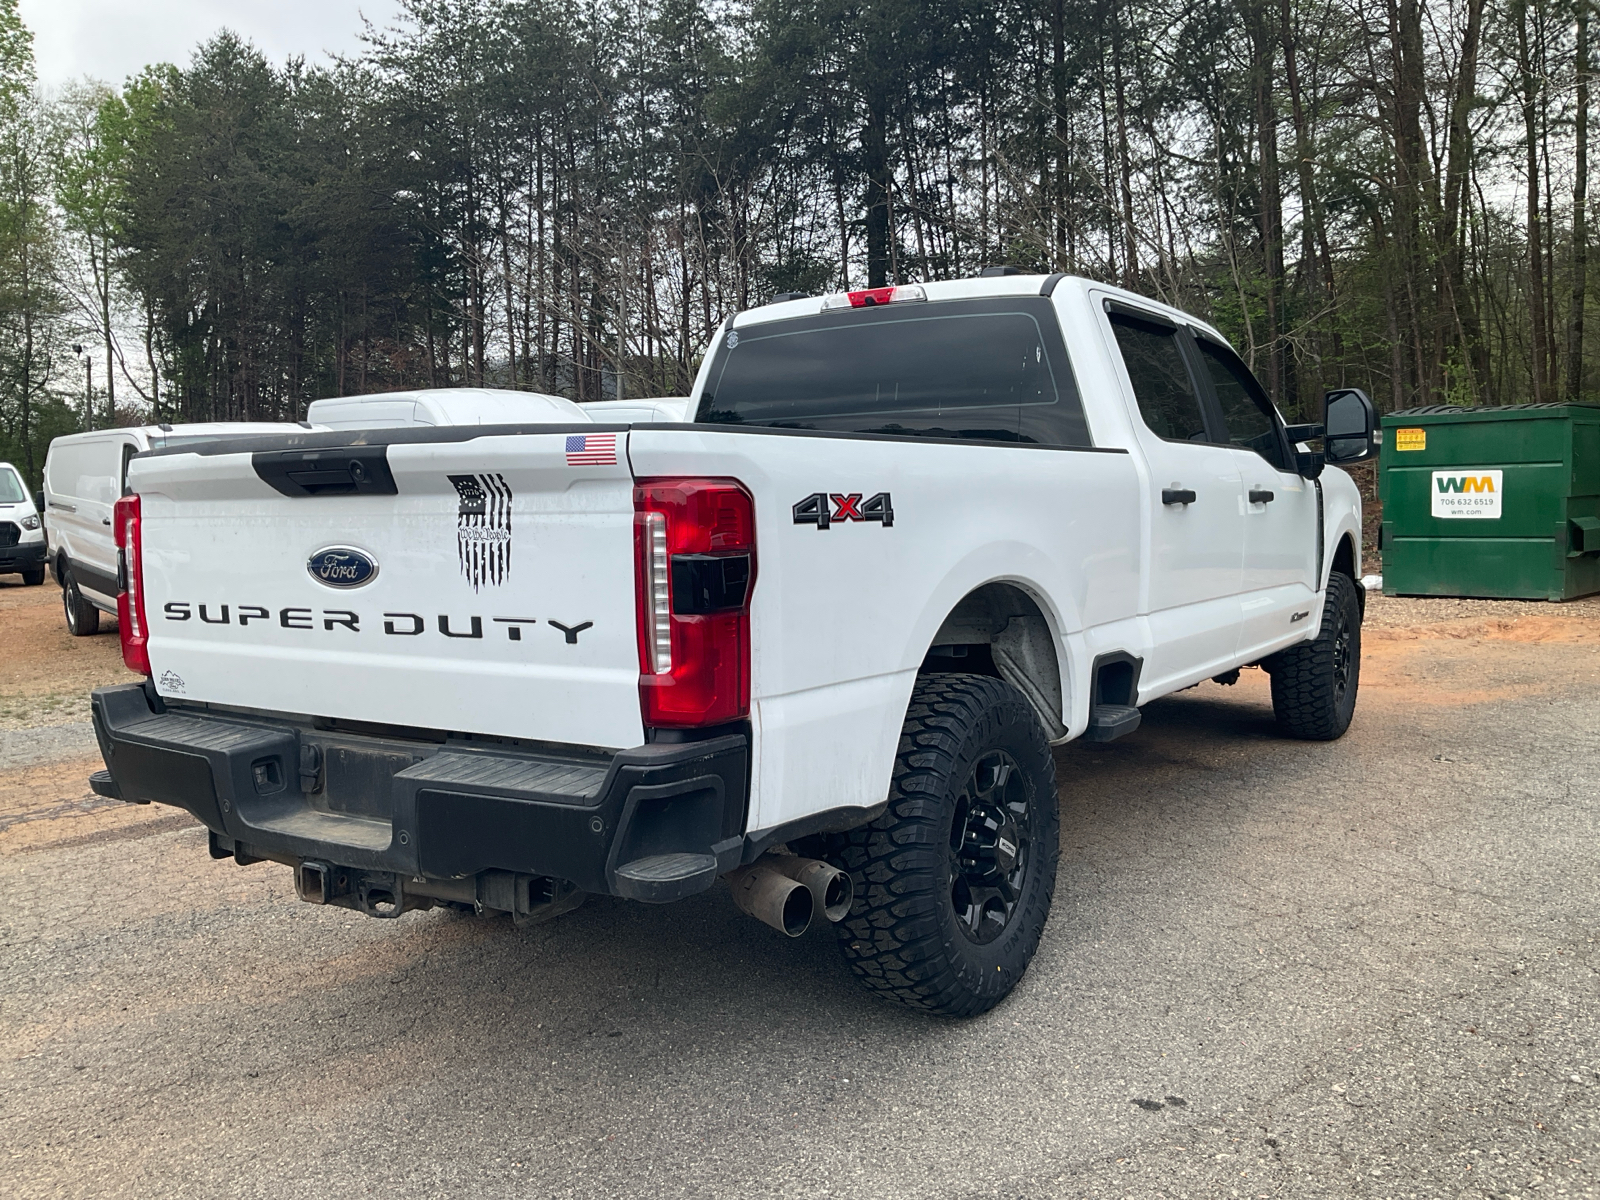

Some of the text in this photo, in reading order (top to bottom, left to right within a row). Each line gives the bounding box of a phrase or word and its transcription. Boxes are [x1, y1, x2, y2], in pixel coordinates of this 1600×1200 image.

[1436, 477, 1495, 493] WM
[320, 554, 359, 579] Ford
[164, 601, 594, 644] SUPER DUTY
